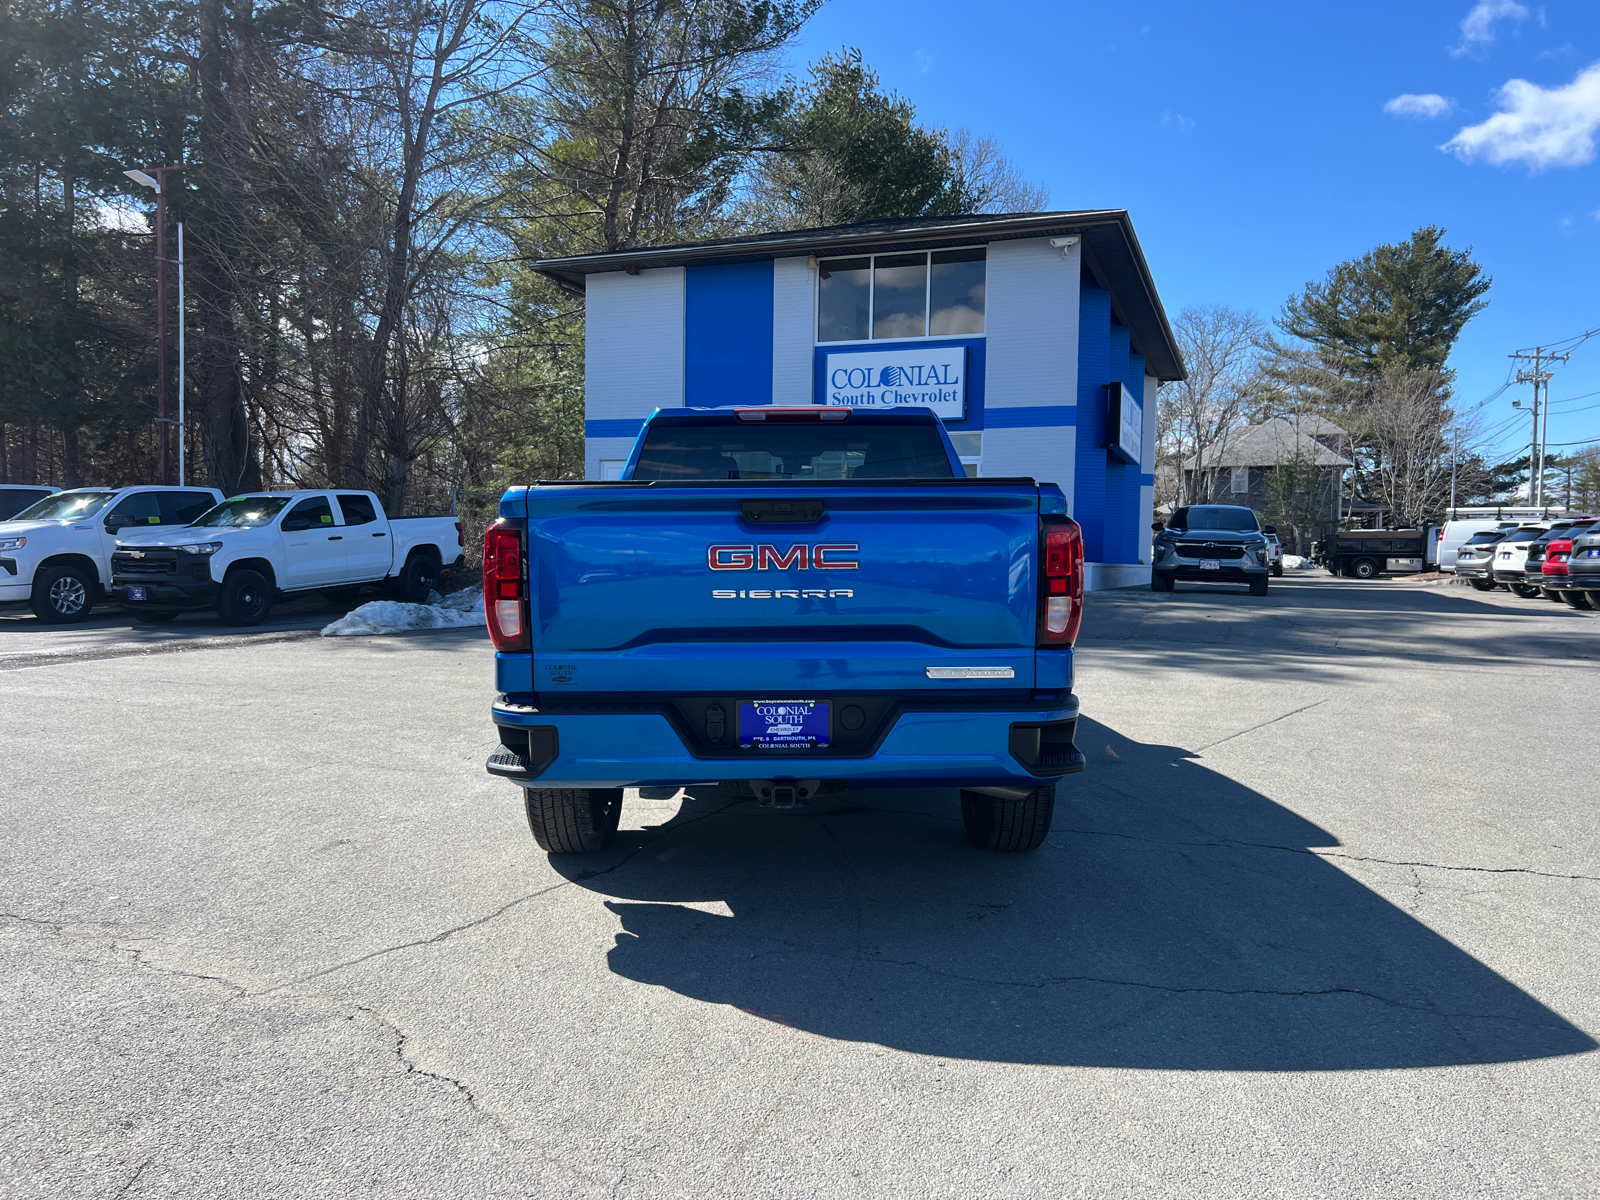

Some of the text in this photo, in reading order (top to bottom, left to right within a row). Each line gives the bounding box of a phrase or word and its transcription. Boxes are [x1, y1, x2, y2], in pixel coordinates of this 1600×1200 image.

[831, 364, 959, 389] COLONIAL
[832, 388, 958, 405] South Chevrolet
[708, 543, 859, 571] GMC
[712, 589, 854, 598] SIERRA
[756, 706, 812, 716] COLONIAL
[765, 715, 803, 724] SOUTH
